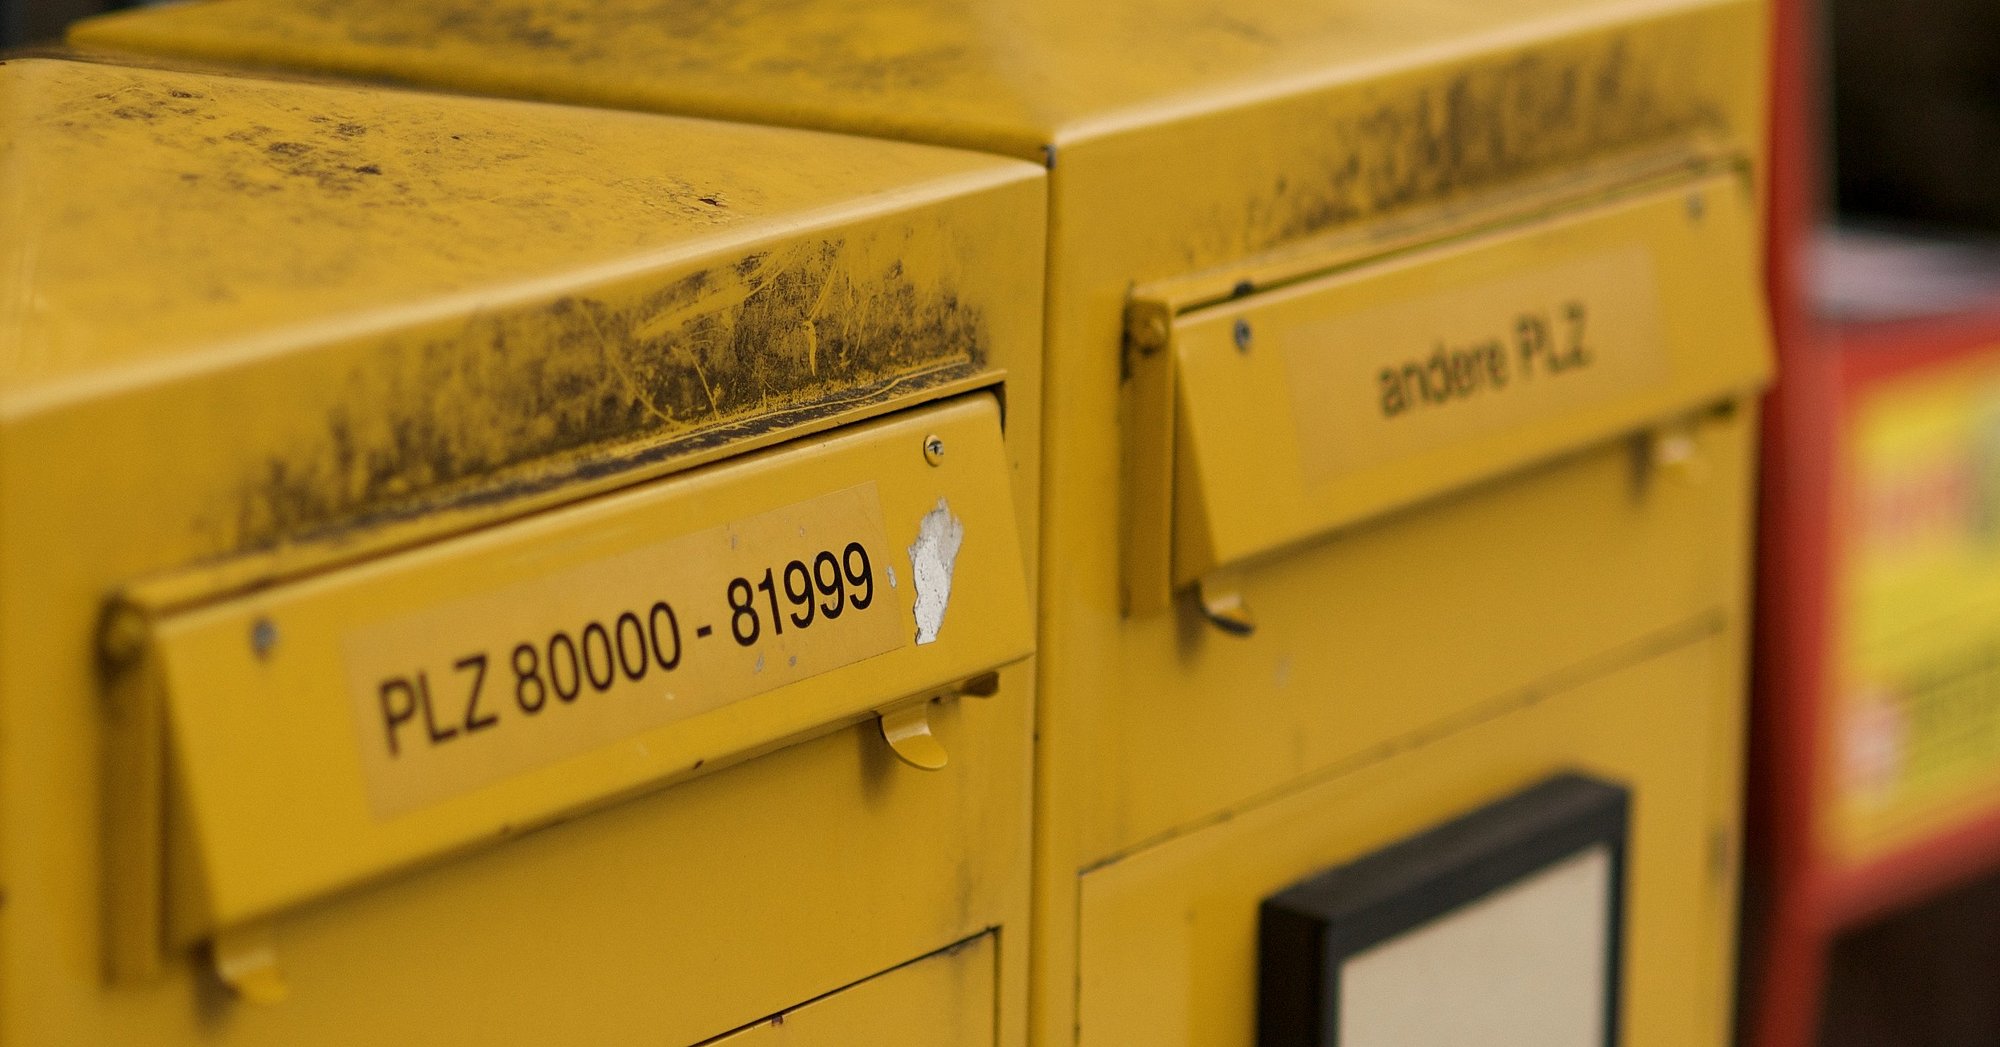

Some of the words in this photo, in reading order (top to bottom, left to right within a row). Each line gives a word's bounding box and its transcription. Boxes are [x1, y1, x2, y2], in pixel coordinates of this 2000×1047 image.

[1378, 341, 1508, 418] andere
[1515, 302, 1594, 379] PLZ
[378, 654, 499, 758] PLZ
[511, 602, 682, 714] 80000
[696, 624, 713, 638] -
[727, 541, 875, 647] 81999
